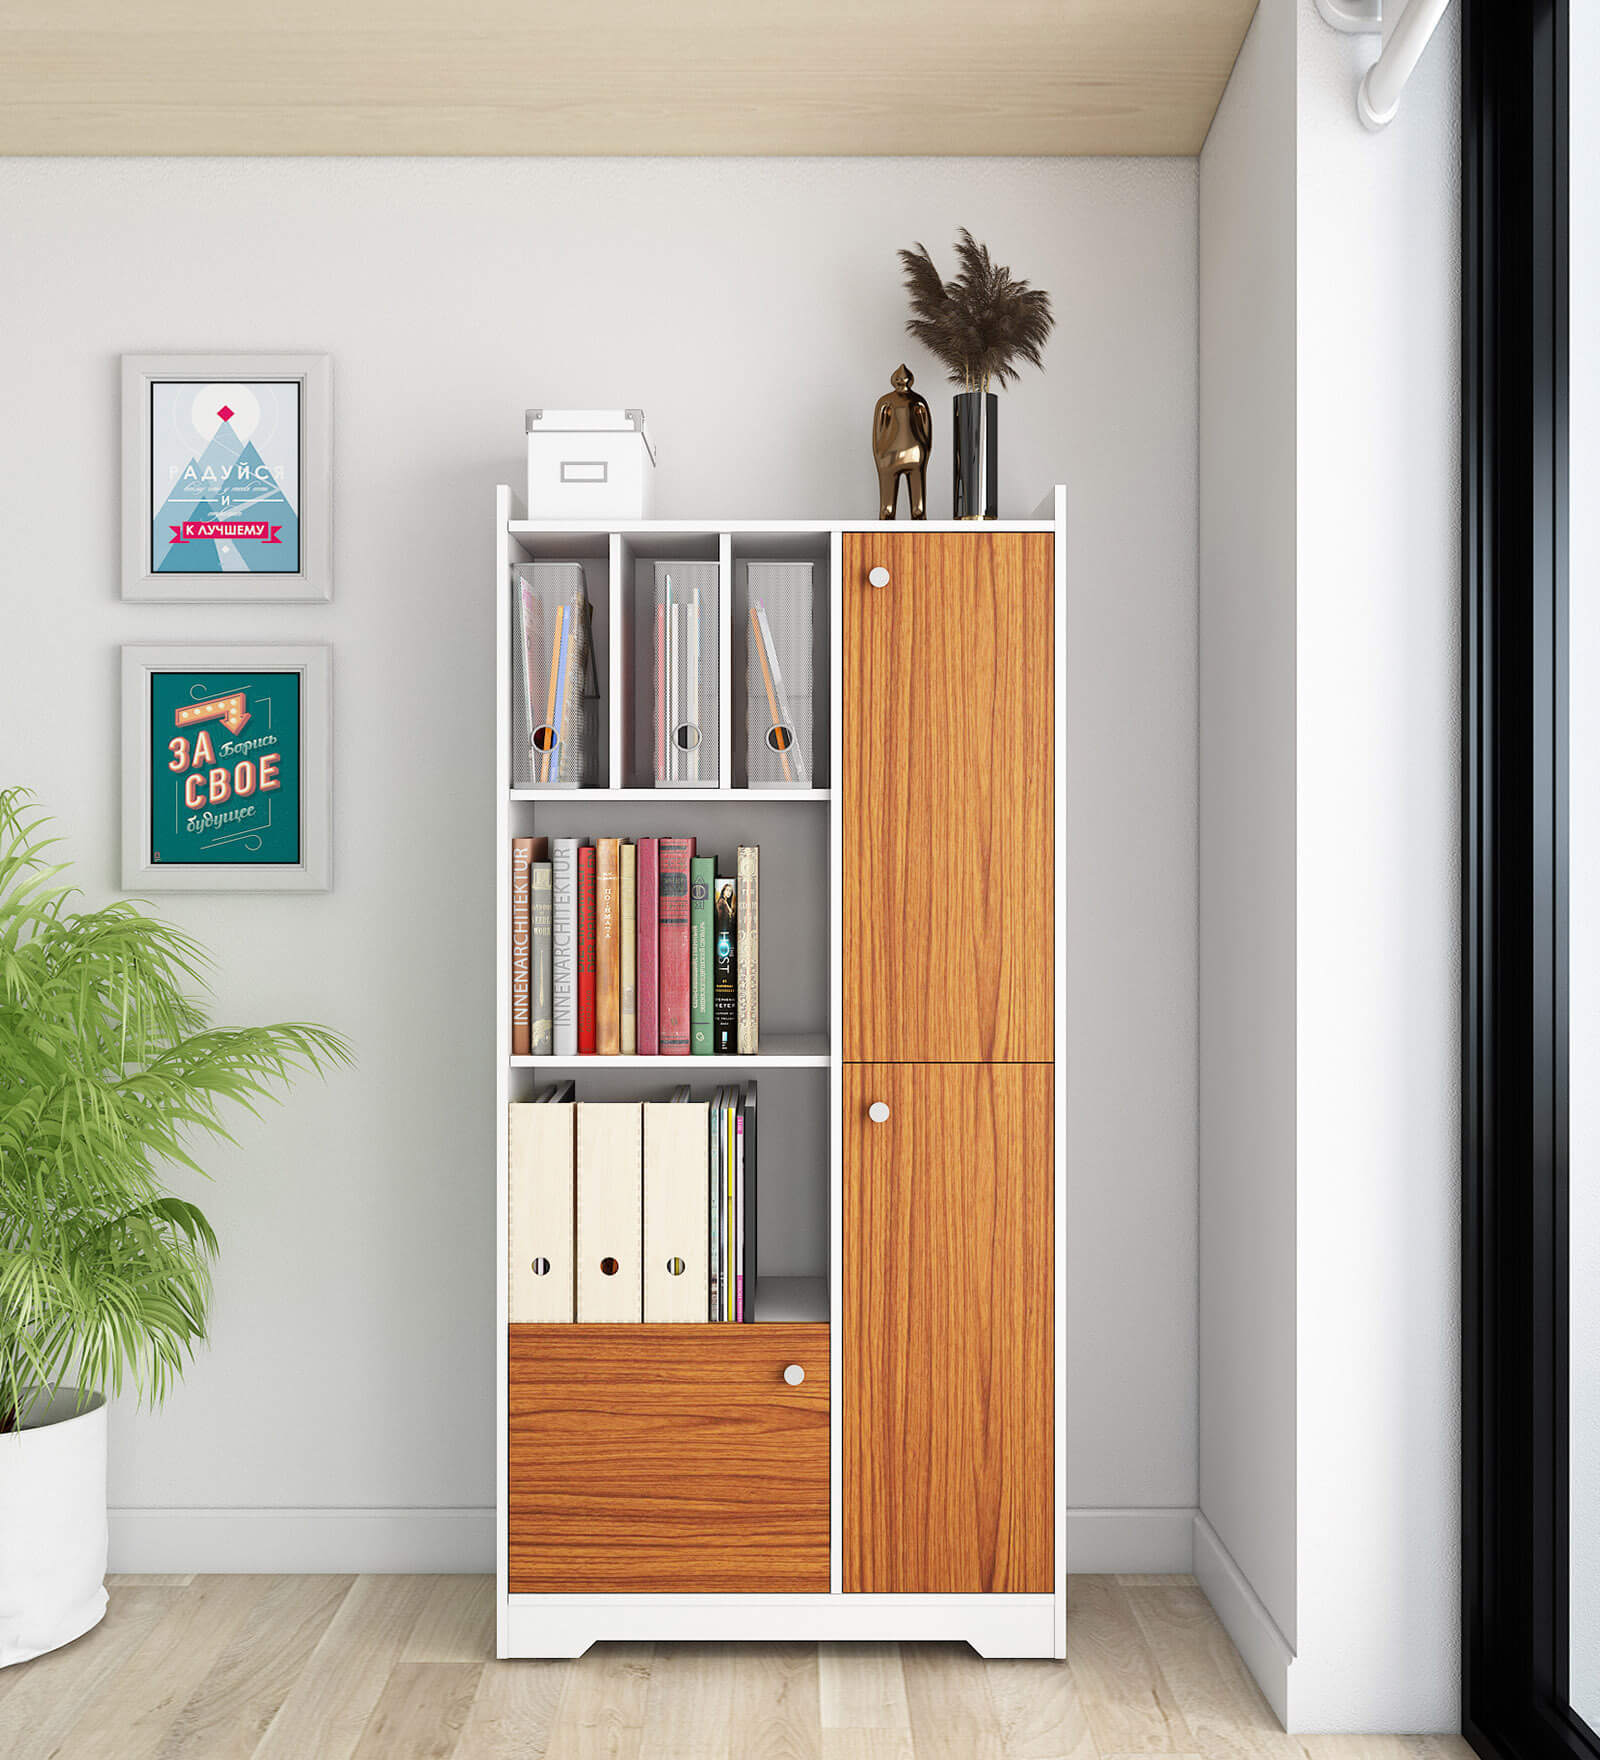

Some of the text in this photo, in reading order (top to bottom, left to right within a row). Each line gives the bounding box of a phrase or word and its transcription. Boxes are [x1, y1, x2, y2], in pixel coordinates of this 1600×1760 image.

[169, 462, 284, 480] РАДУЙСЯ
[221, 495, 230, 506] И
[186, 525, 265, 536] К ЛУЧШЕМУ
[168, 730, 216, 773] ЗА
[218, 735, 277, 757] Борись
[185, 753, 281, 810] СВОЕ
[186, 805, 256, 834] будущее
[513, 847, 529, 1025] INNENARCHITEKTUR
[553, 847, 571, 1026] INNENARCHITEKTUR
[718, 931, 731, 974] HOST
